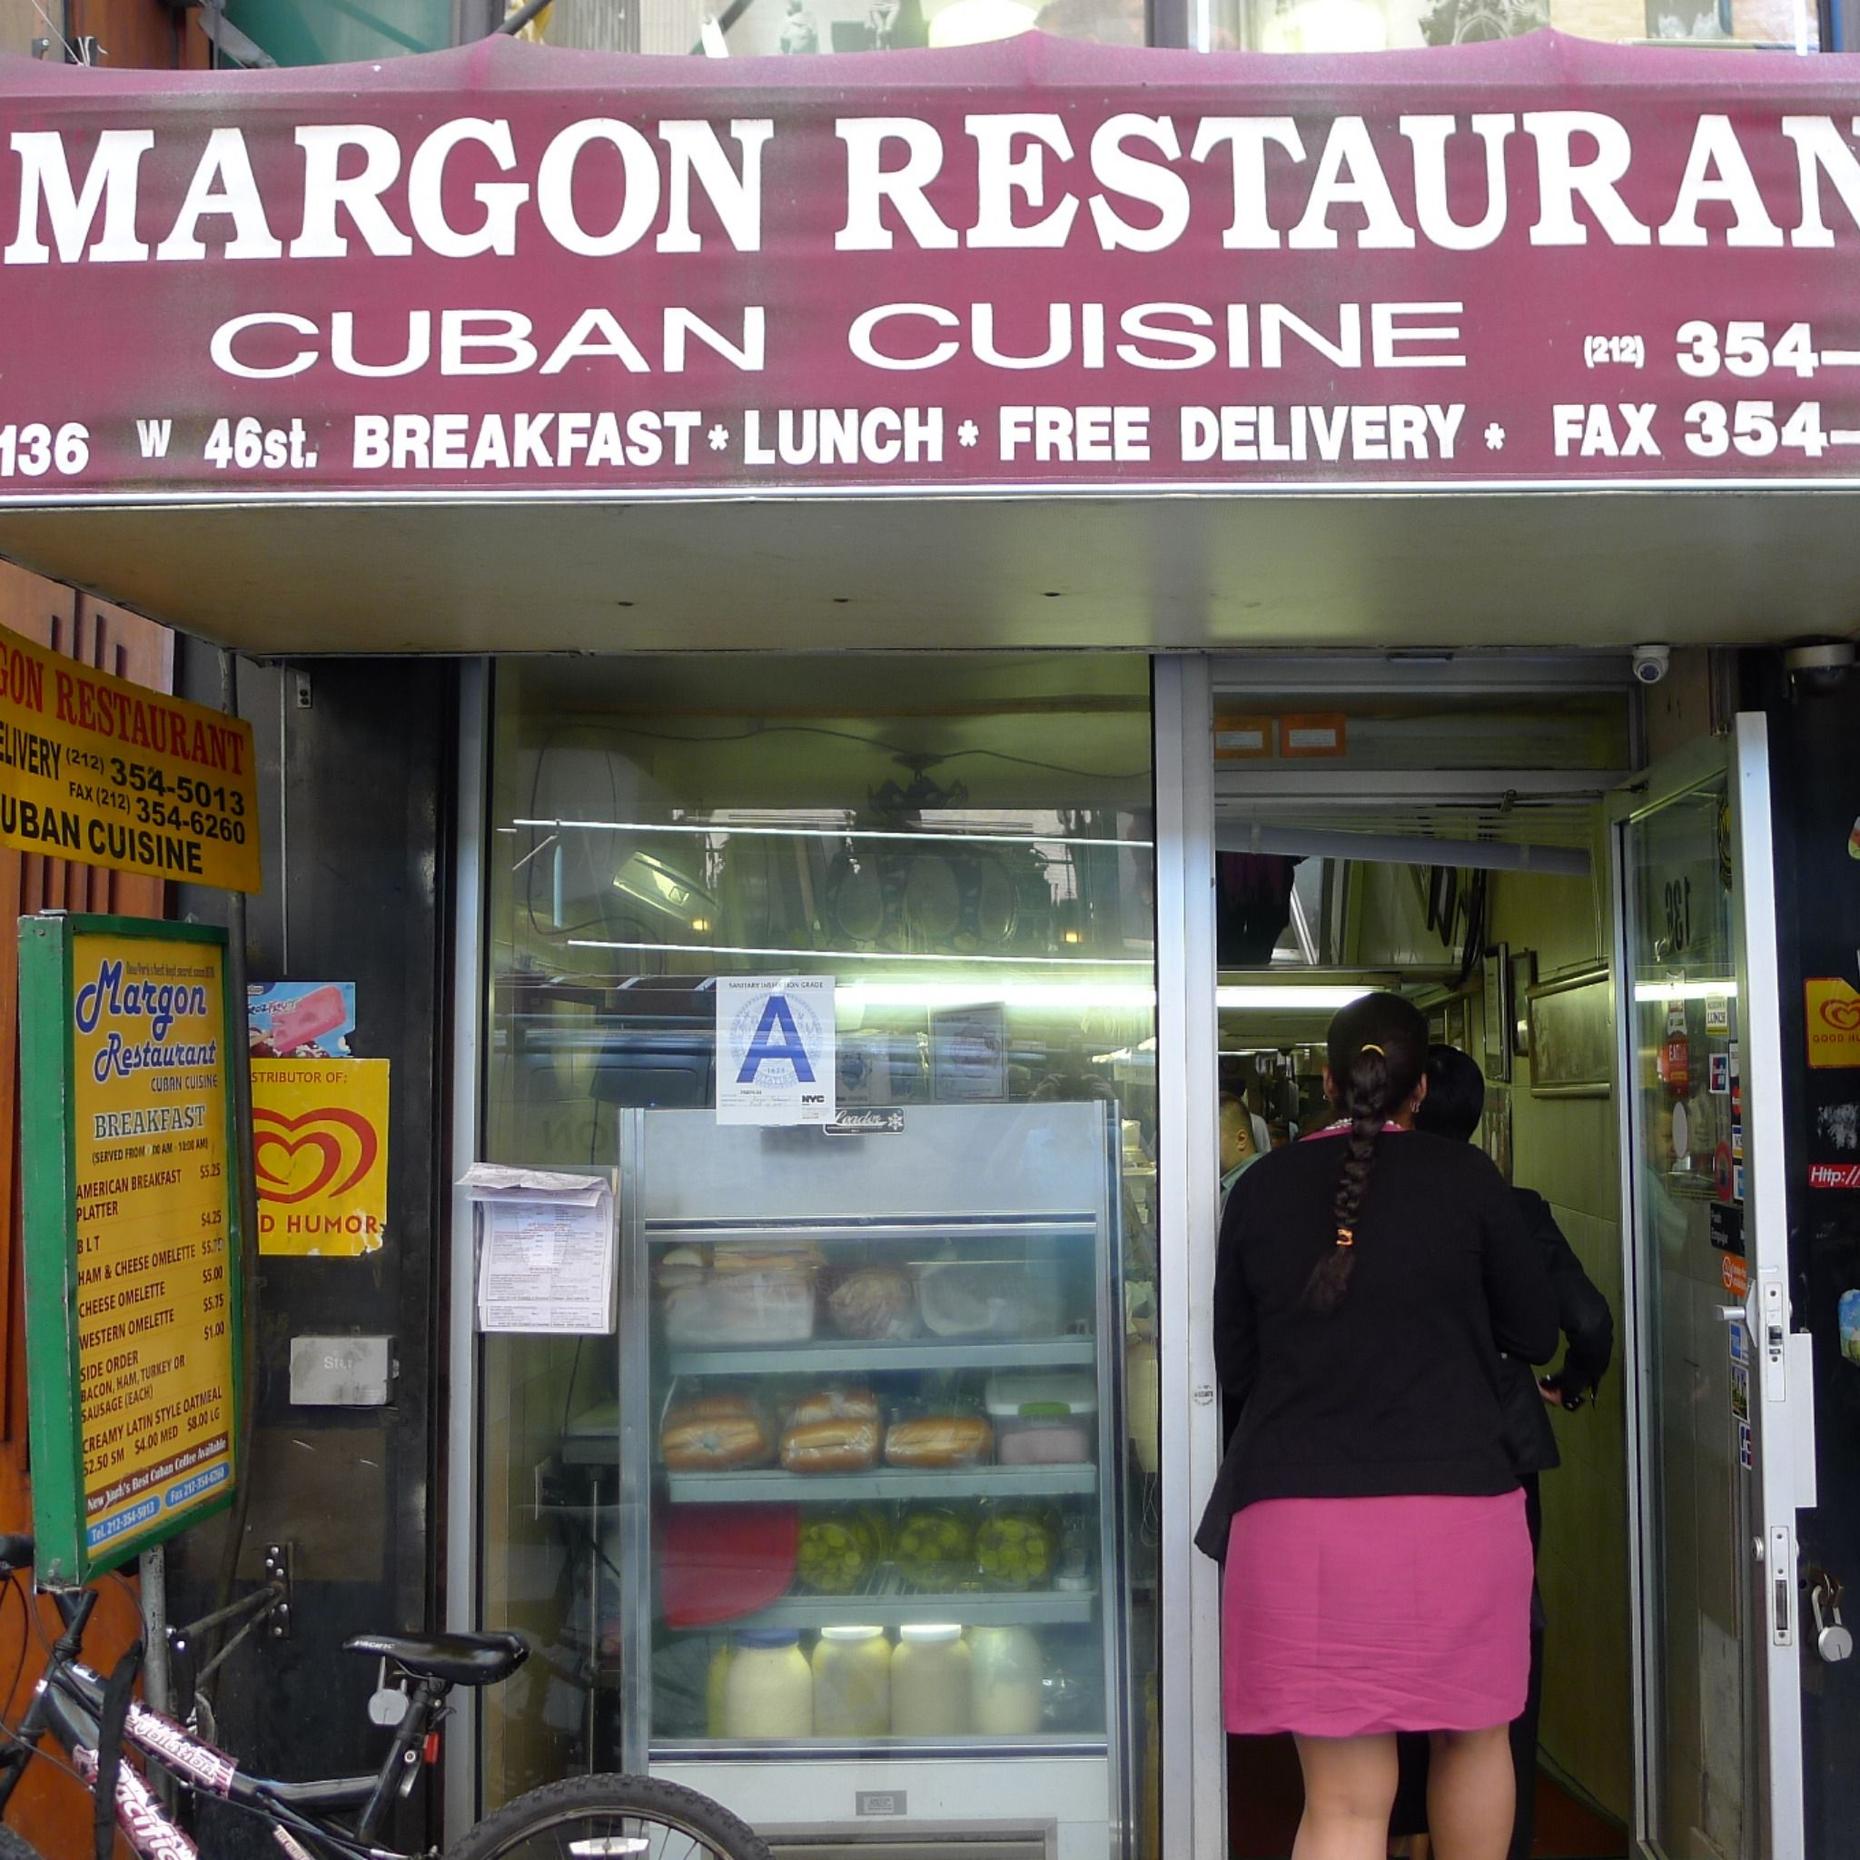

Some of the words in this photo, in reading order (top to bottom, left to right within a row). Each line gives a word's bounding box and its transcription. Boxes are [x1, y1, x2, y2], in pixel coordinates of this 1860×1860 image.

[4, 117, 775, 265] MARGON
[210, 306, 765, 379] CUBAN
[848, 302, 1467, 371] CUISINE
[1584, 335, 1645, 369] (212)
[0, 423, 90, 477] 136
[136, 419, 172, 458] W
[203, 416, 318, 469] 46st.
[353, 411, 702, 469] BREAKFAST
[743, 407, 944, 466] LUNCH
[1000, 405, 1150, 462] FREE
[1180, 403, 1466, 463] DELIVERY
[1552, 402, 1662, 457] FAX
[55, 668, 246, 776] RESTAURANT
[66, 747, 105, 776] (212)
[110, 757, 245, 817] 354-5013
[69, 780, 94, 802] FAX
[96, 785, 131, 816] (212)
[135, 797, 246, 845] 354-6260
[88, 818, 203, 875] CUISINE
[76, 960, 207, 1041] Margon
[801, 981, 824, 989] GRADE
[94, 1032, 216, 1082] Restaurant
[735, 995, 817, 1083] A
[151, 1077, 182, 1092] CUBAN
[185, 1073, 219, 1090] CUISINE
[801, 1094, 825, 1104] NYC
[95, 1104, 206, 1140] BREAKFAST
[92, 1148, 124, 1166] (SERVED
[124, 1144, 145, 1159] FROM
[76, 1177, 129, 1200] AMERICAN
[131, 1169, 182, 1191] BREAKFAST
[200, 1162, 221, 1179] $5.25
[76, 1201, 119, 1222] PLATTER
[201, 1209, 222, 1227] $4.25
[287, 1214, 379, 1234] HUMOR
[78, 1266, 102, 1287] HAM
[104, 1264, 112, 1279] &
[115, 1255, 150, 1277] CHEESE
[152, 1244, 196, 1268] OMELETTE
[79, 1295, 116, 1319] CHEESE
[118, 1281, 166, 1308] OMELETTE
[202, 1265, 223, 1284] $5.00
[79, 1326, 126, 1351] WESTERN
[128, 1308, 175, 1336] OMELETTE
[80, 1361, 103, 1383] SIDE
[105, 1352, 139, 1376] ORDER
[204, 1321, 225, 1341] $1.00
[80, 1381, 114, 1403] BACON,
[141, 1361, 172, 1381] TURKEY
[174, 1355, 185, 1370] OR
[81, 1396, 122, 1423] SAUSAGE
[124, 1384, 154, 1409] (EACH)
[83, 1427, 125, 1454] CREAMY
[127, 1413, 153, 1437] LATIN
[155, 1402, 182, 1426] STYLE
[183, 1386, 223, 1413] OATMEAL
[111, 1448, 125, 1466] SM
[134, 1436, 159, 1455] $4.00
[160, 1425, 178, 1444] MED
[210, 1407, 220, 1424] LG
[87, 1497, 105, 1511] New
[132, 1472, 149, 1491] Best
[150, 1462, 174, 1483] Cuban
